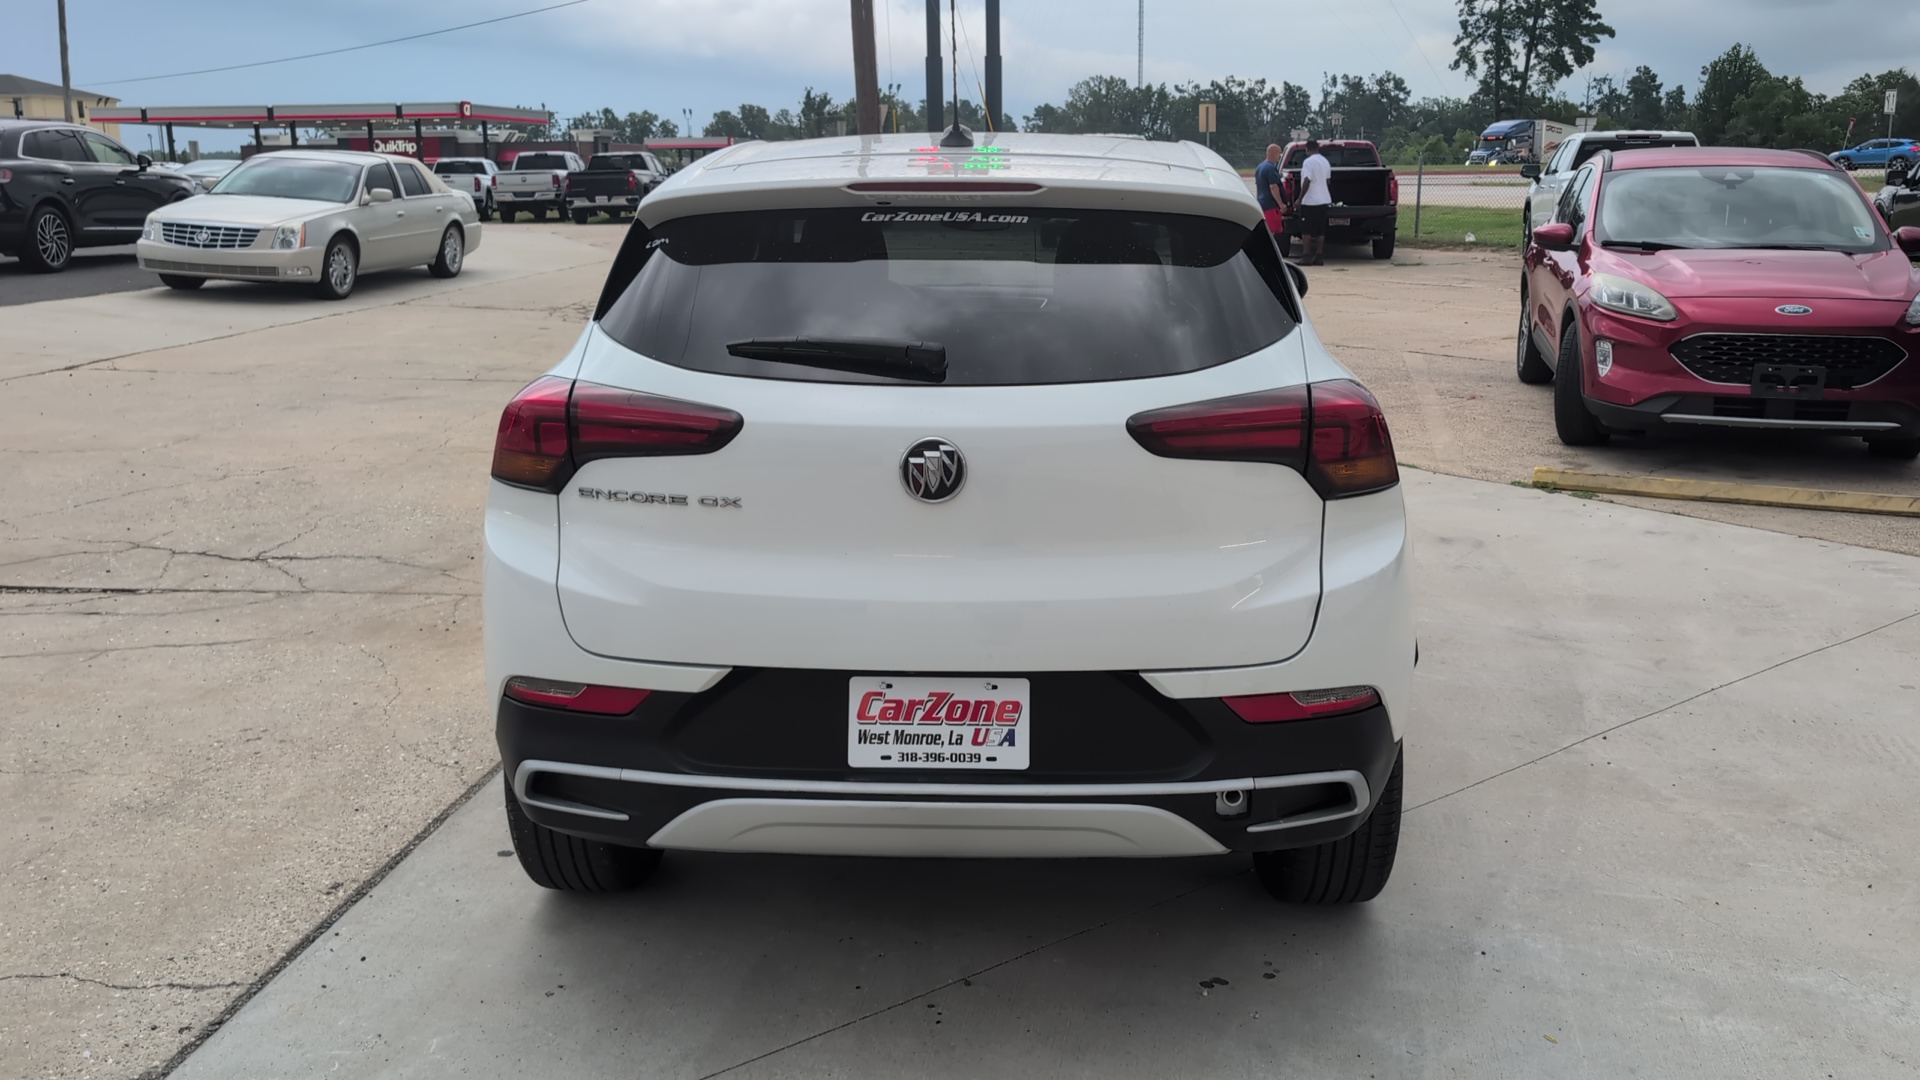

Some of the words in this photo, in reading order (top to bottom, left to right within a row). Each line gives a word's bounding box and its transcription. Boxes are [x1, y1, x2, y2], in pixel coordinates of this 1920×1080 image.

[374, 140, 417, 154] QuikTrip
[861, 212, 1029, 224] CarZoneUSA.com
[578, 487, 688, 506] ENCORE
[698, 496, 742, 508] GX
[856, 690, 1023, 727] CarZone
[857, 728, 891, 746] West
[892, 729, 945, 749] Monroe,
[948, 731, 963, 746] La
[971, 728, 1015, 747] USA
[897, 752, 981, 762] 318-396-0039
